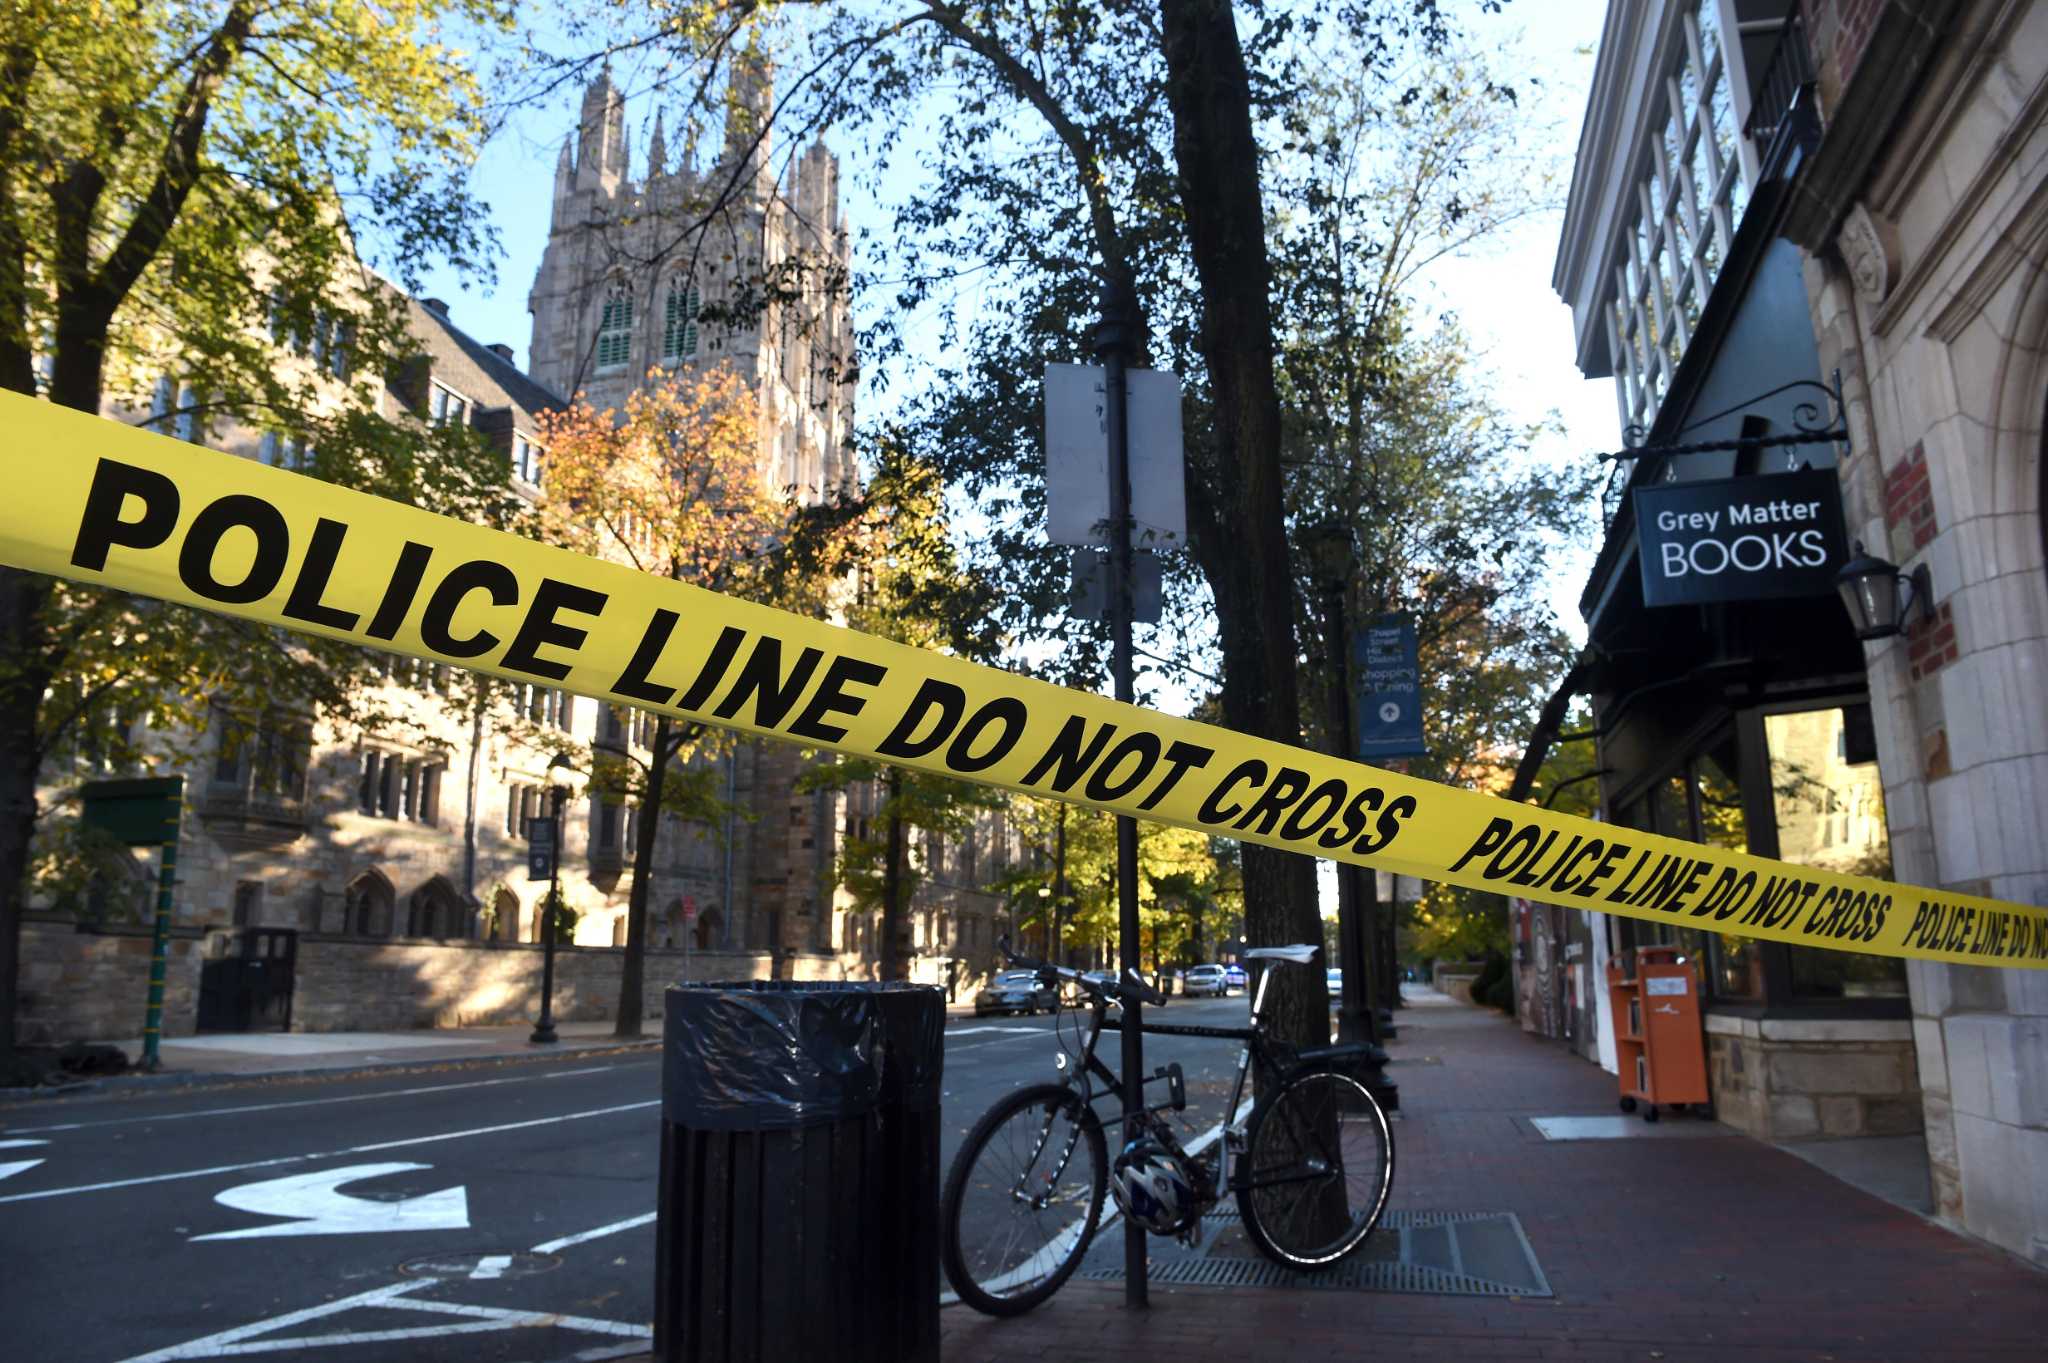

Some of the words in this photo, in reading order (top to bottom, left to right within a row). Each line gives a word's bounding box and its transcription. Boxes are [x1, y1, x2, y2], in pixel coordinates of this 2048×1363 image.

[1657, 510, 1720, 532] Grey
[1729, 499, 1820, 526] Matter
[1661, 530, 1827, 578] BOOKS
[70, 457, 609, 681] POLICE
[610, 608, 888, 743] LINE
[874, 678, 1027, 772] DO
[1019, 714, 1215, 810] NOT
[1197, 759, 1417, 856] CROSS
[1448, 817, 1632, 897] POLICE
[1603, 850, 1714, 913] LINE
[1689, 866, 1757, 921] DO
[1737, 876, 1820, 931] NOT
[1803, 885, 1893, 943] CROSS
[1901, 901, 1976, 953] POLICE
[1969, 910, 2010, 956] LINE
[2007, 915, 2031, 958] DO
